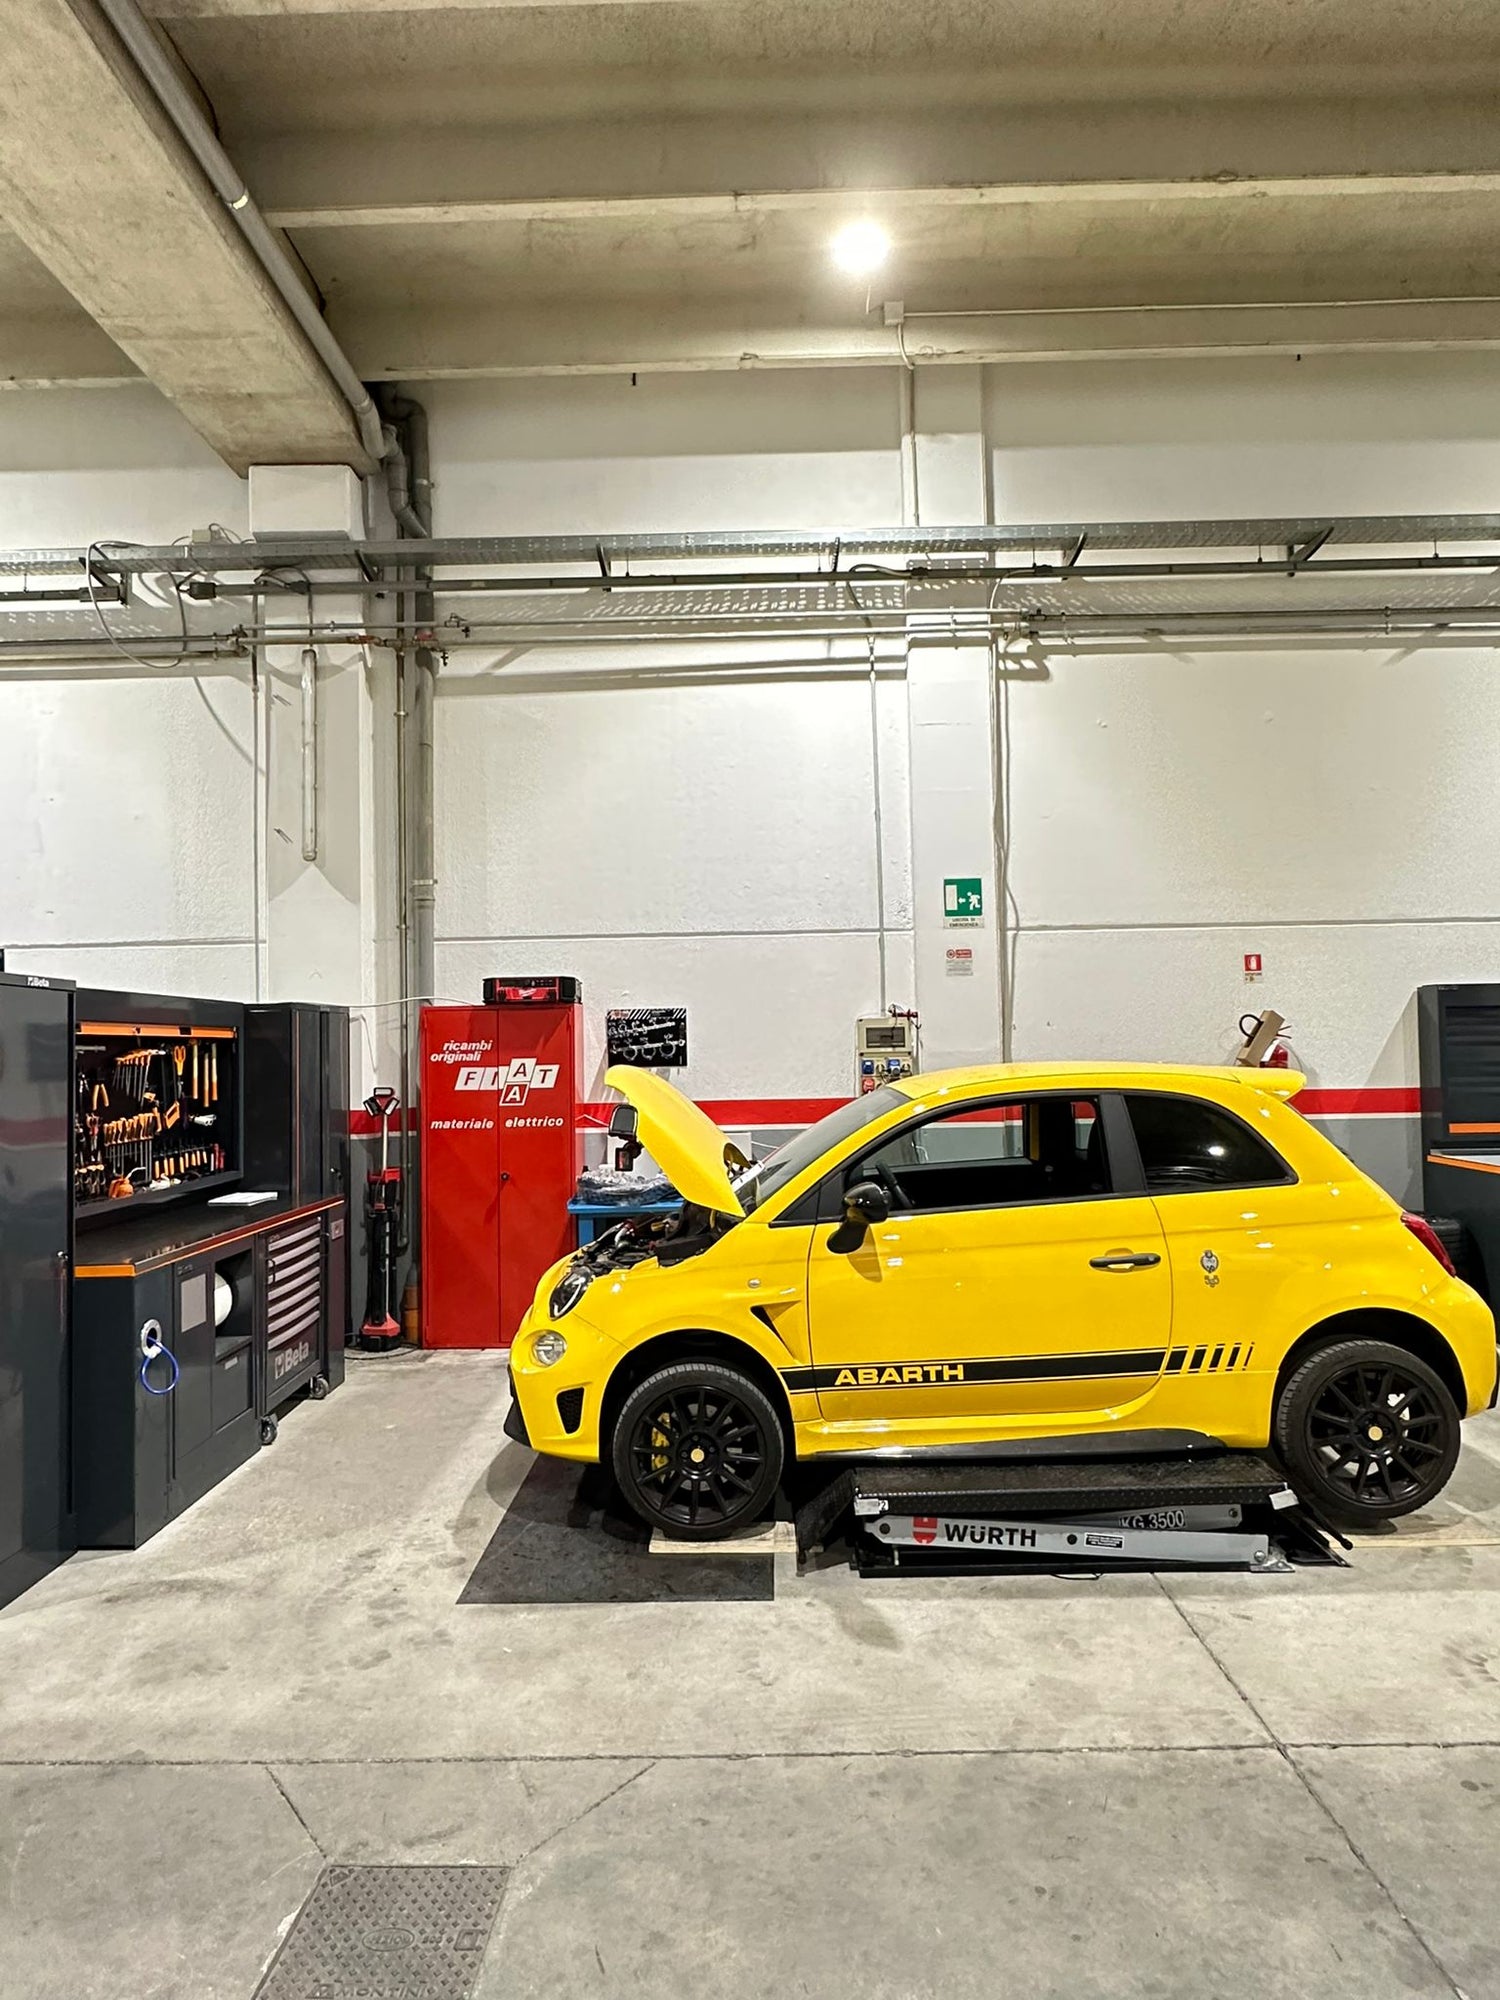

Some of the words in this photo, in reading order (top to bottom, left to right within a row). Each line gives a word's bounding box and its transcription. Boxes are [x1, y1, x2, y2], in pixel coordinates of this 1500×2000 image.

[443, 1040, 493, 1051] ricambi
[430, 1051, 482, 1064] originali
[460, 1060, 556, 1089] FIAT
[430, 1118, 494, 1129] materiale
[505, 1116, 564, 1128] elettrico
[284, 1341, 310, 1373] Beta
[834, 1364, 964, 1386] ABARTH
[1150, 1510, 1185, 1529] 3500
